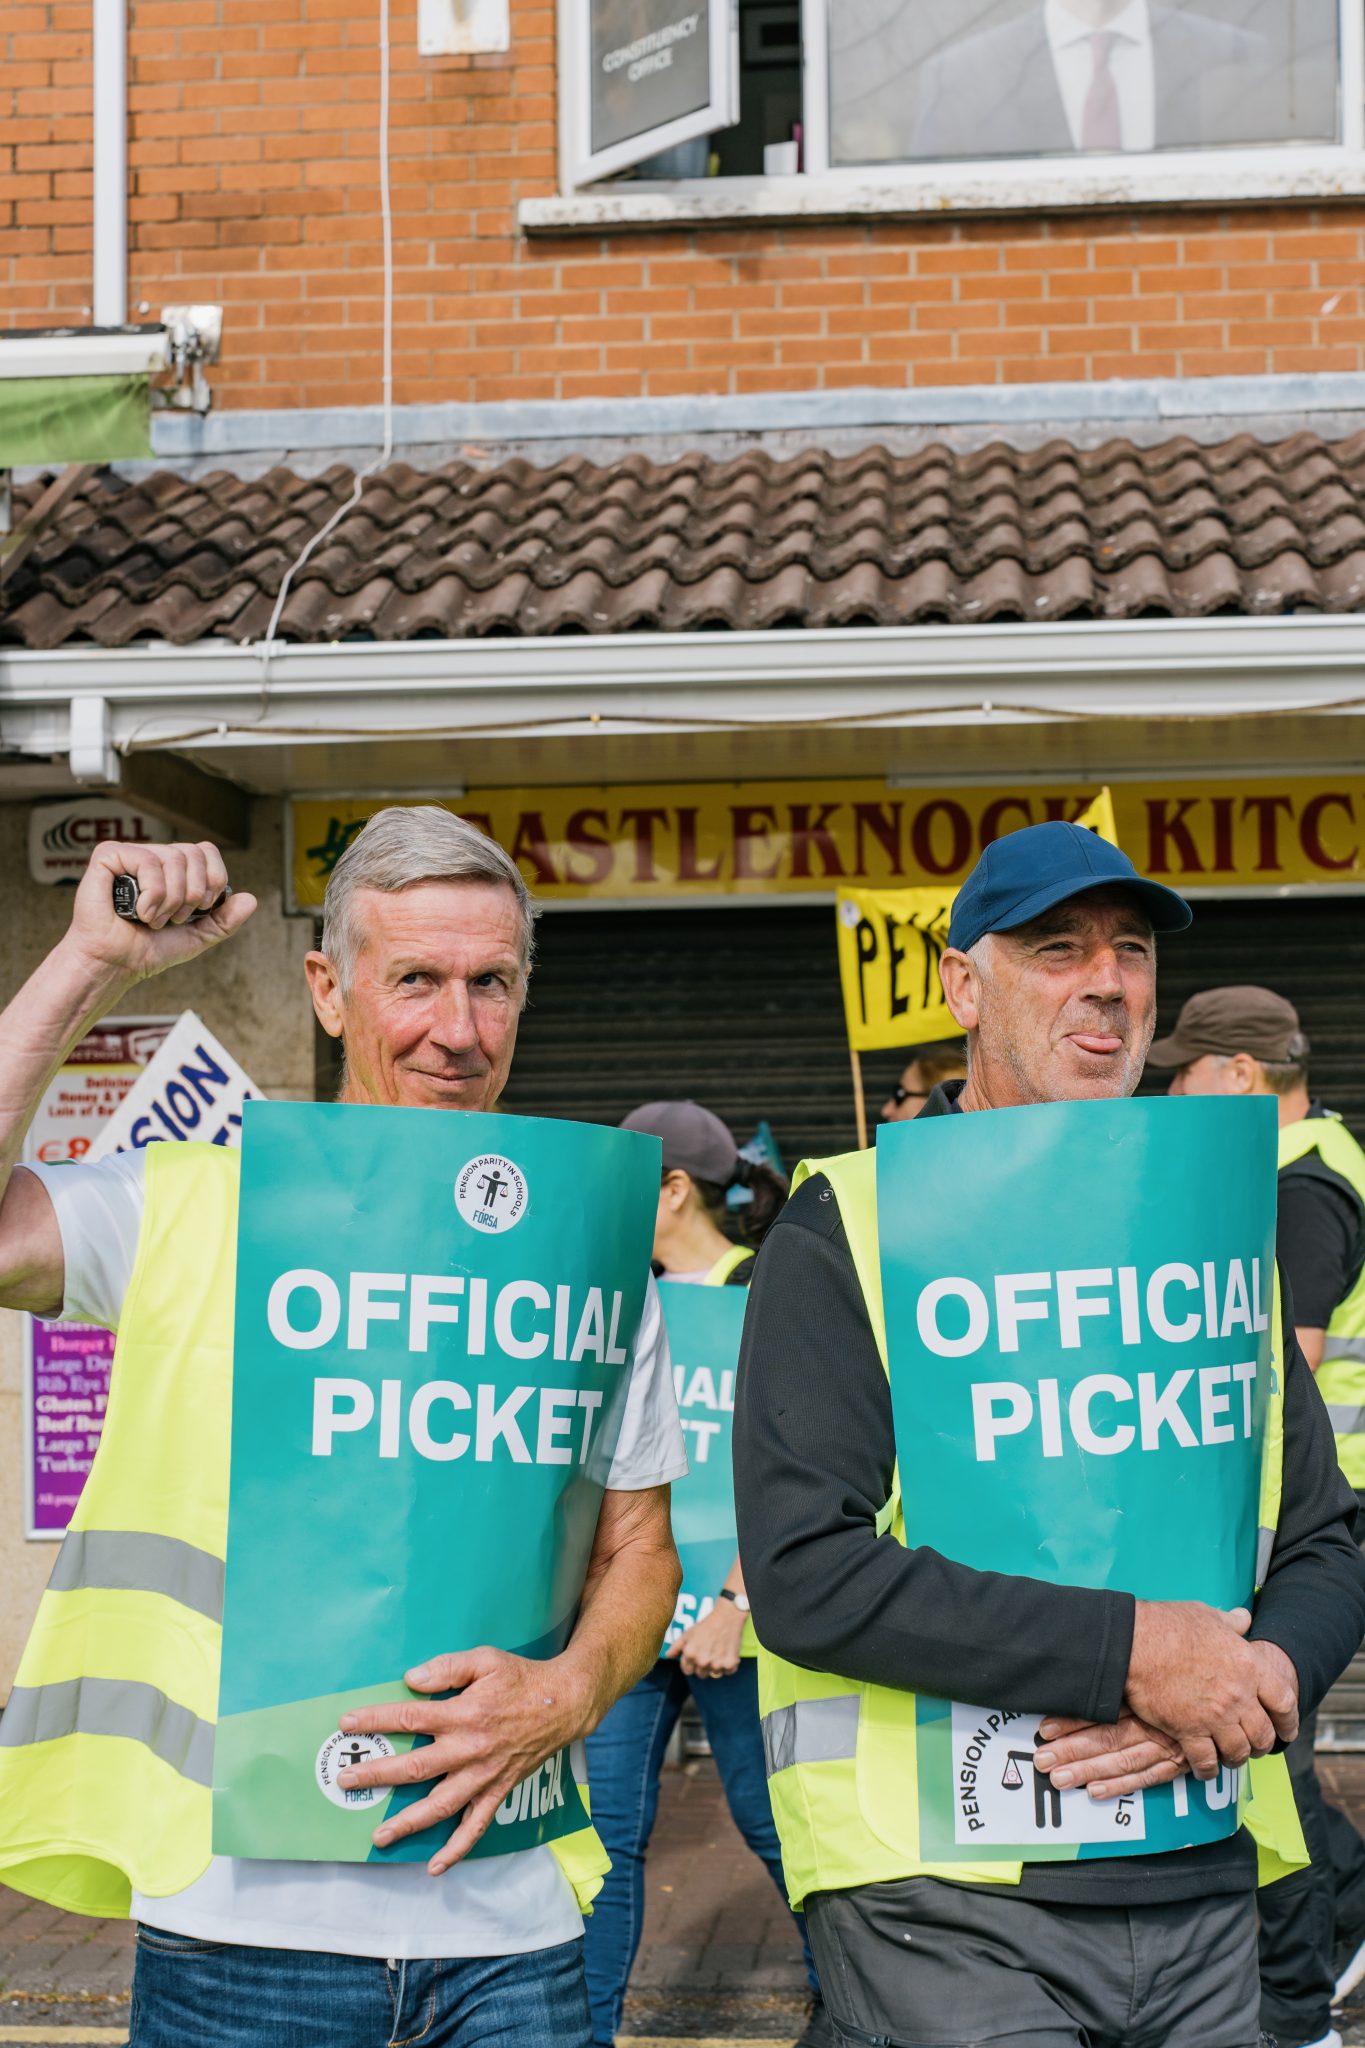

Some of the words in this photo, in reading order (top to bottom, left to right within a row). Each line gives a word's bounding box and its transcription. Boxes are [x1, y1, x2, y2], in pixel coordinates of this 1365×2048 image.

[627, 46, 673, 82] OFFICE
[69, 816, 152, 843] CELL
[456, 796, 1097, 886] ASTLEKNOC
[1145, 793, 1360, 874] KITC
[117, 1044, 230, 1154] SION
[459, 1162, 479, 1199] PENSION
[478, 1157, 509, 1168] PARITY
[507, 1165, 516, 1176] IN
[510, 1175, 524, 1217] SCHOOLS
[266, 1268, 628, 1365] OFFICIAL
[915, 1257, 1269, 1358] OFFICIAL
[312, 1377, 603, 1466] PICKET
[970, 1361, 1257, 1462] PICKET
[320, 1744, 334, 1786] PENSION
[958, 1727, 992, 1832] PENSION
